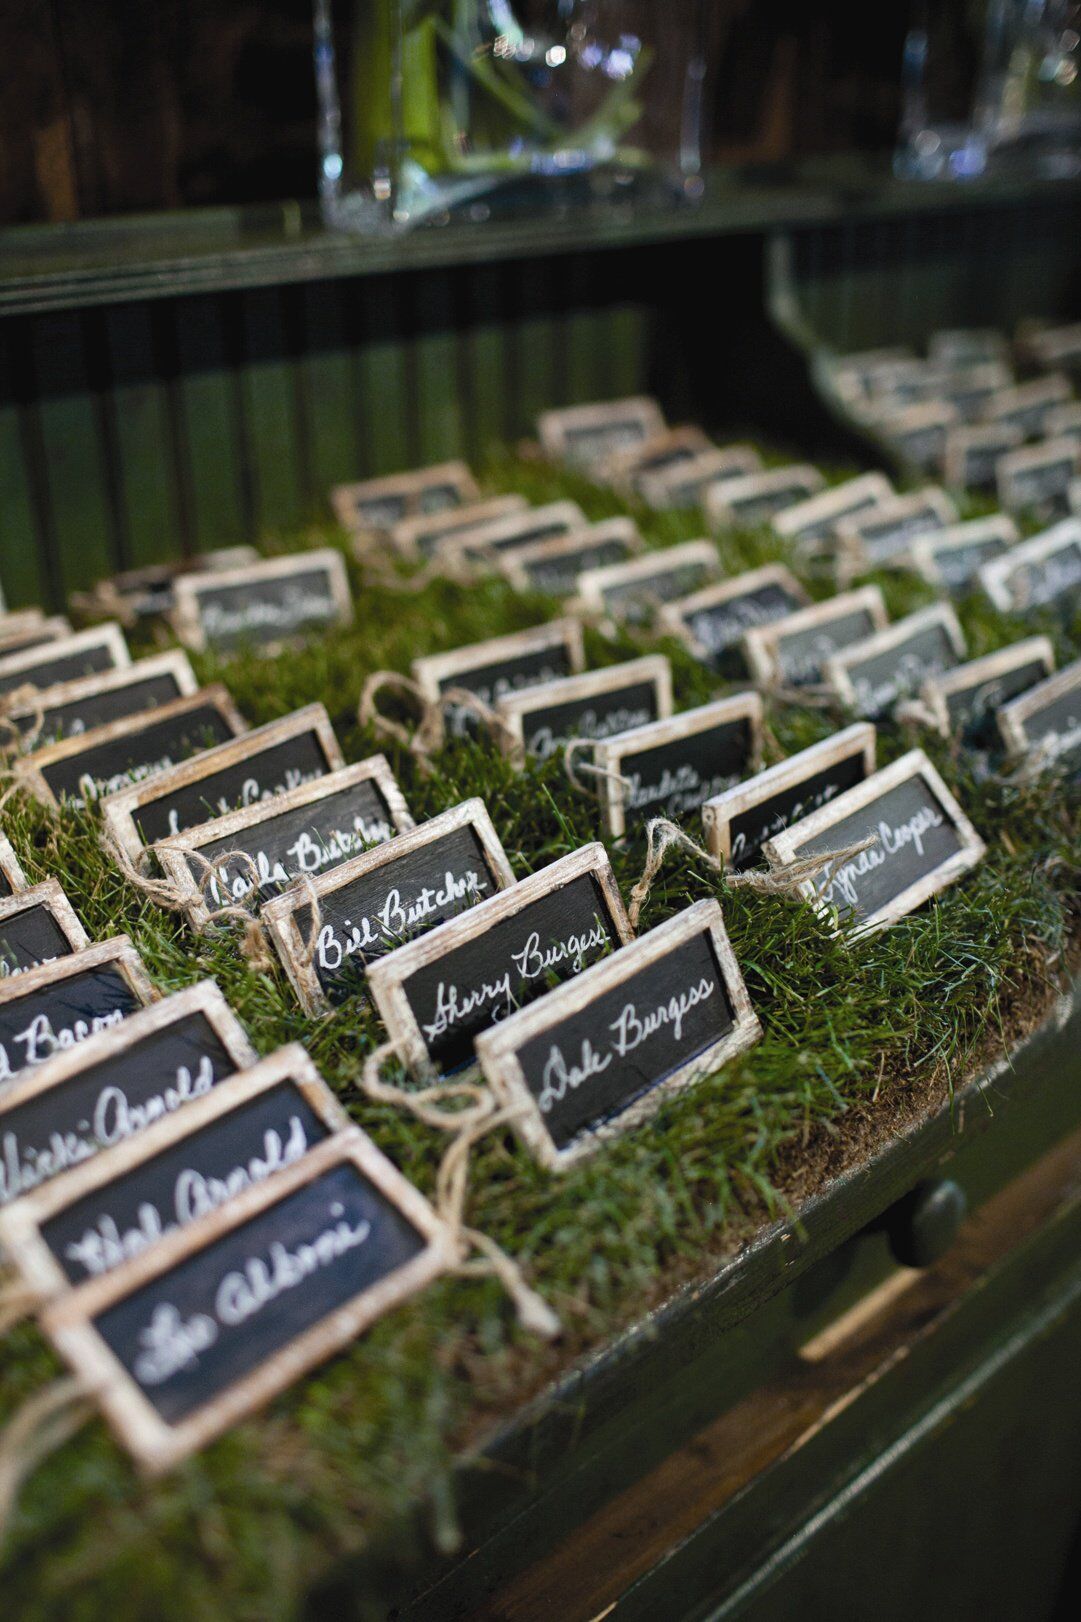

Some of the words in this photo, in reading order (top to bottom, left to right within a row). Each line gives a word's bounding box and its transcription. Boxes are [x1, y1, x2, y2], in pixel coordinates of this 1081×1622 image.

[879, 806, 943, 856] Cooper
[317, 917, 379, 969] Bill
[377, 870, 488, 937] Butcher
[422, 972, 512, 1043] Sherry
[510, 925, 611, 979] Burgess
[538, 1043, 633, 1113] Dale
[609, 978, 714, 1058] Burgess
[93, 1055, 214, 1147] Arnold
[174, 1115, 307, 1225] Arnold
